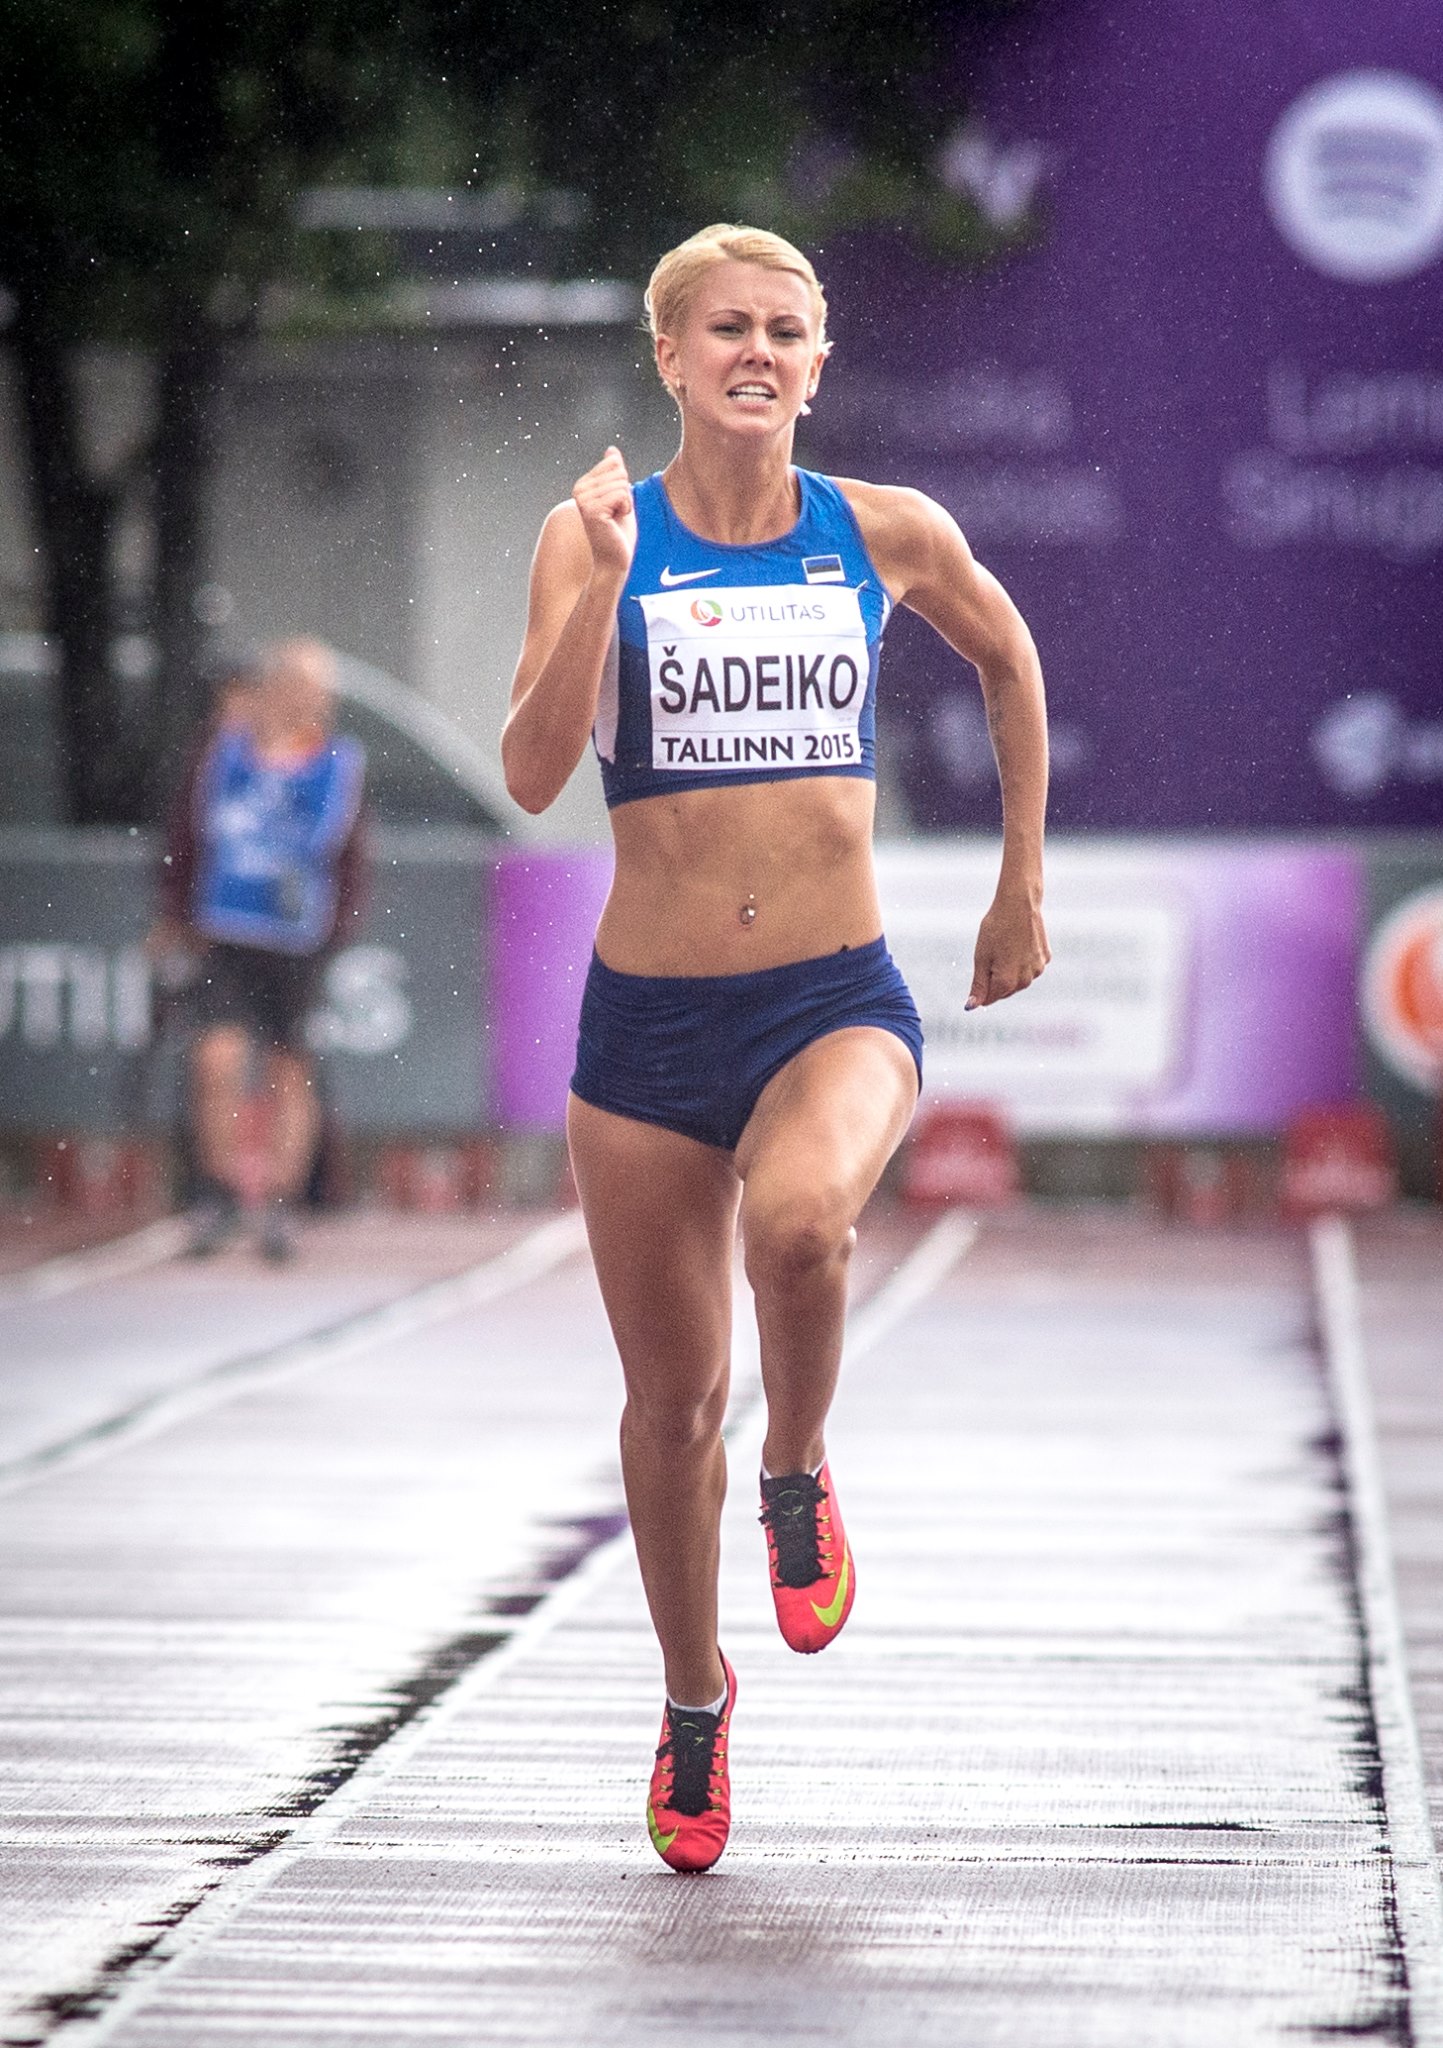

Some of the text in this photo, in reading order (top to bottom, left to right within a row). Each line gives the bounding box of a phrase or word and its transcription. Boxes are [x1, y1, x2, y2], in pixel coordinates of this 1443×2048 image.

[730, 604, 826, 622] UTILITAS
[658, 645, 858, 714] ŠADEIKO
[660, 733, 854, 762] TALLINN 2015
